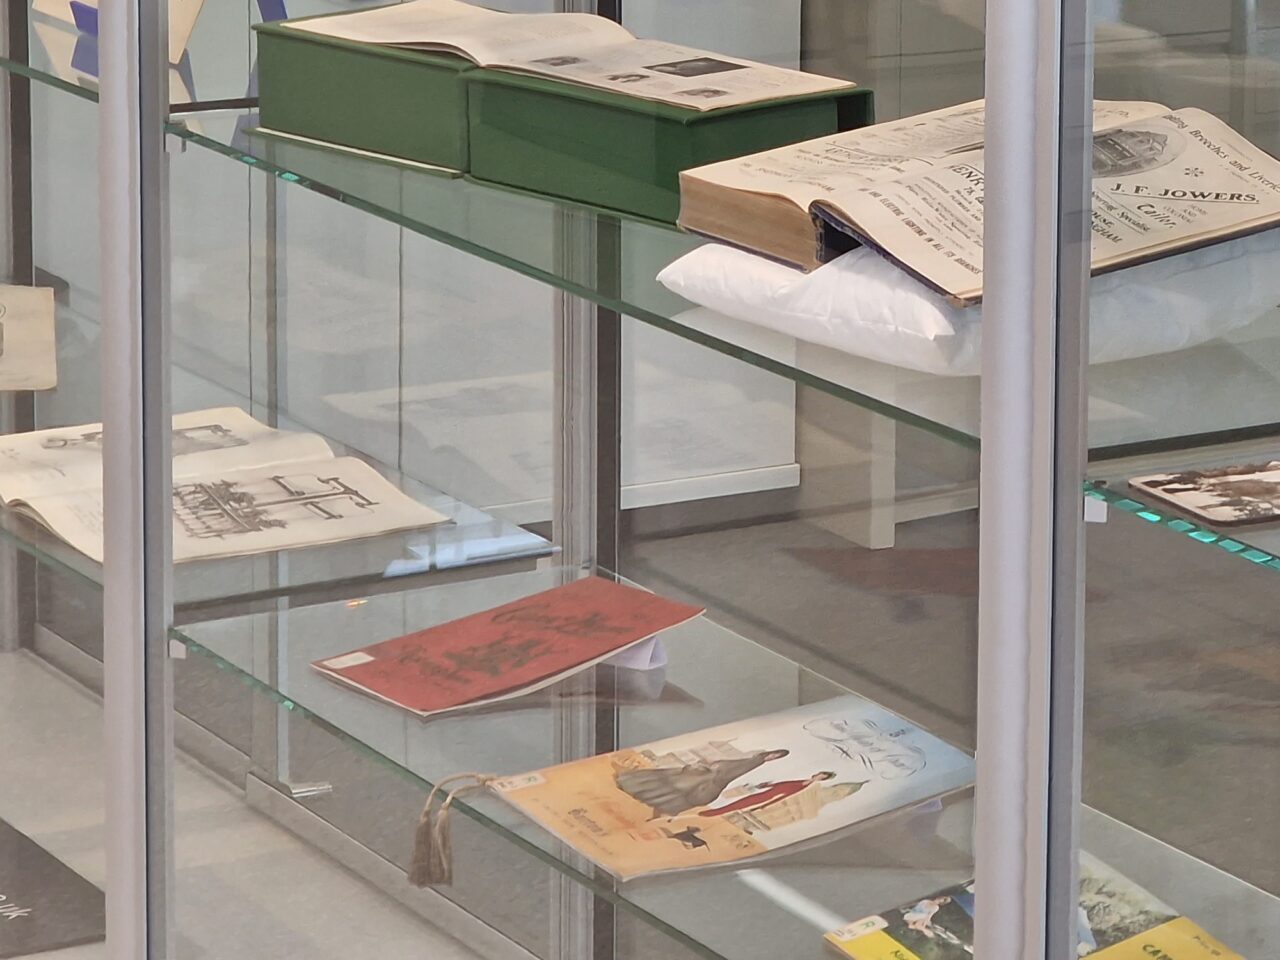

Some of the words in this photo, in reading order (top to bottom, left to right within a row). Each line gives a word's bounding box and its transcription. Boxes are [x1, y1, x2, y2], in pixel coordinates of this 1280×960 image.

[1189, 129, 1230, 160] Breeches
[1229, 159, 1250, 172] and
[1111, 183, 1126, 193] J.
[1134, 185, 1152, 196] F.
[1158, 187, 1260, 203] JOWERS.
[901, 217, 927, 237] LIGHTING
